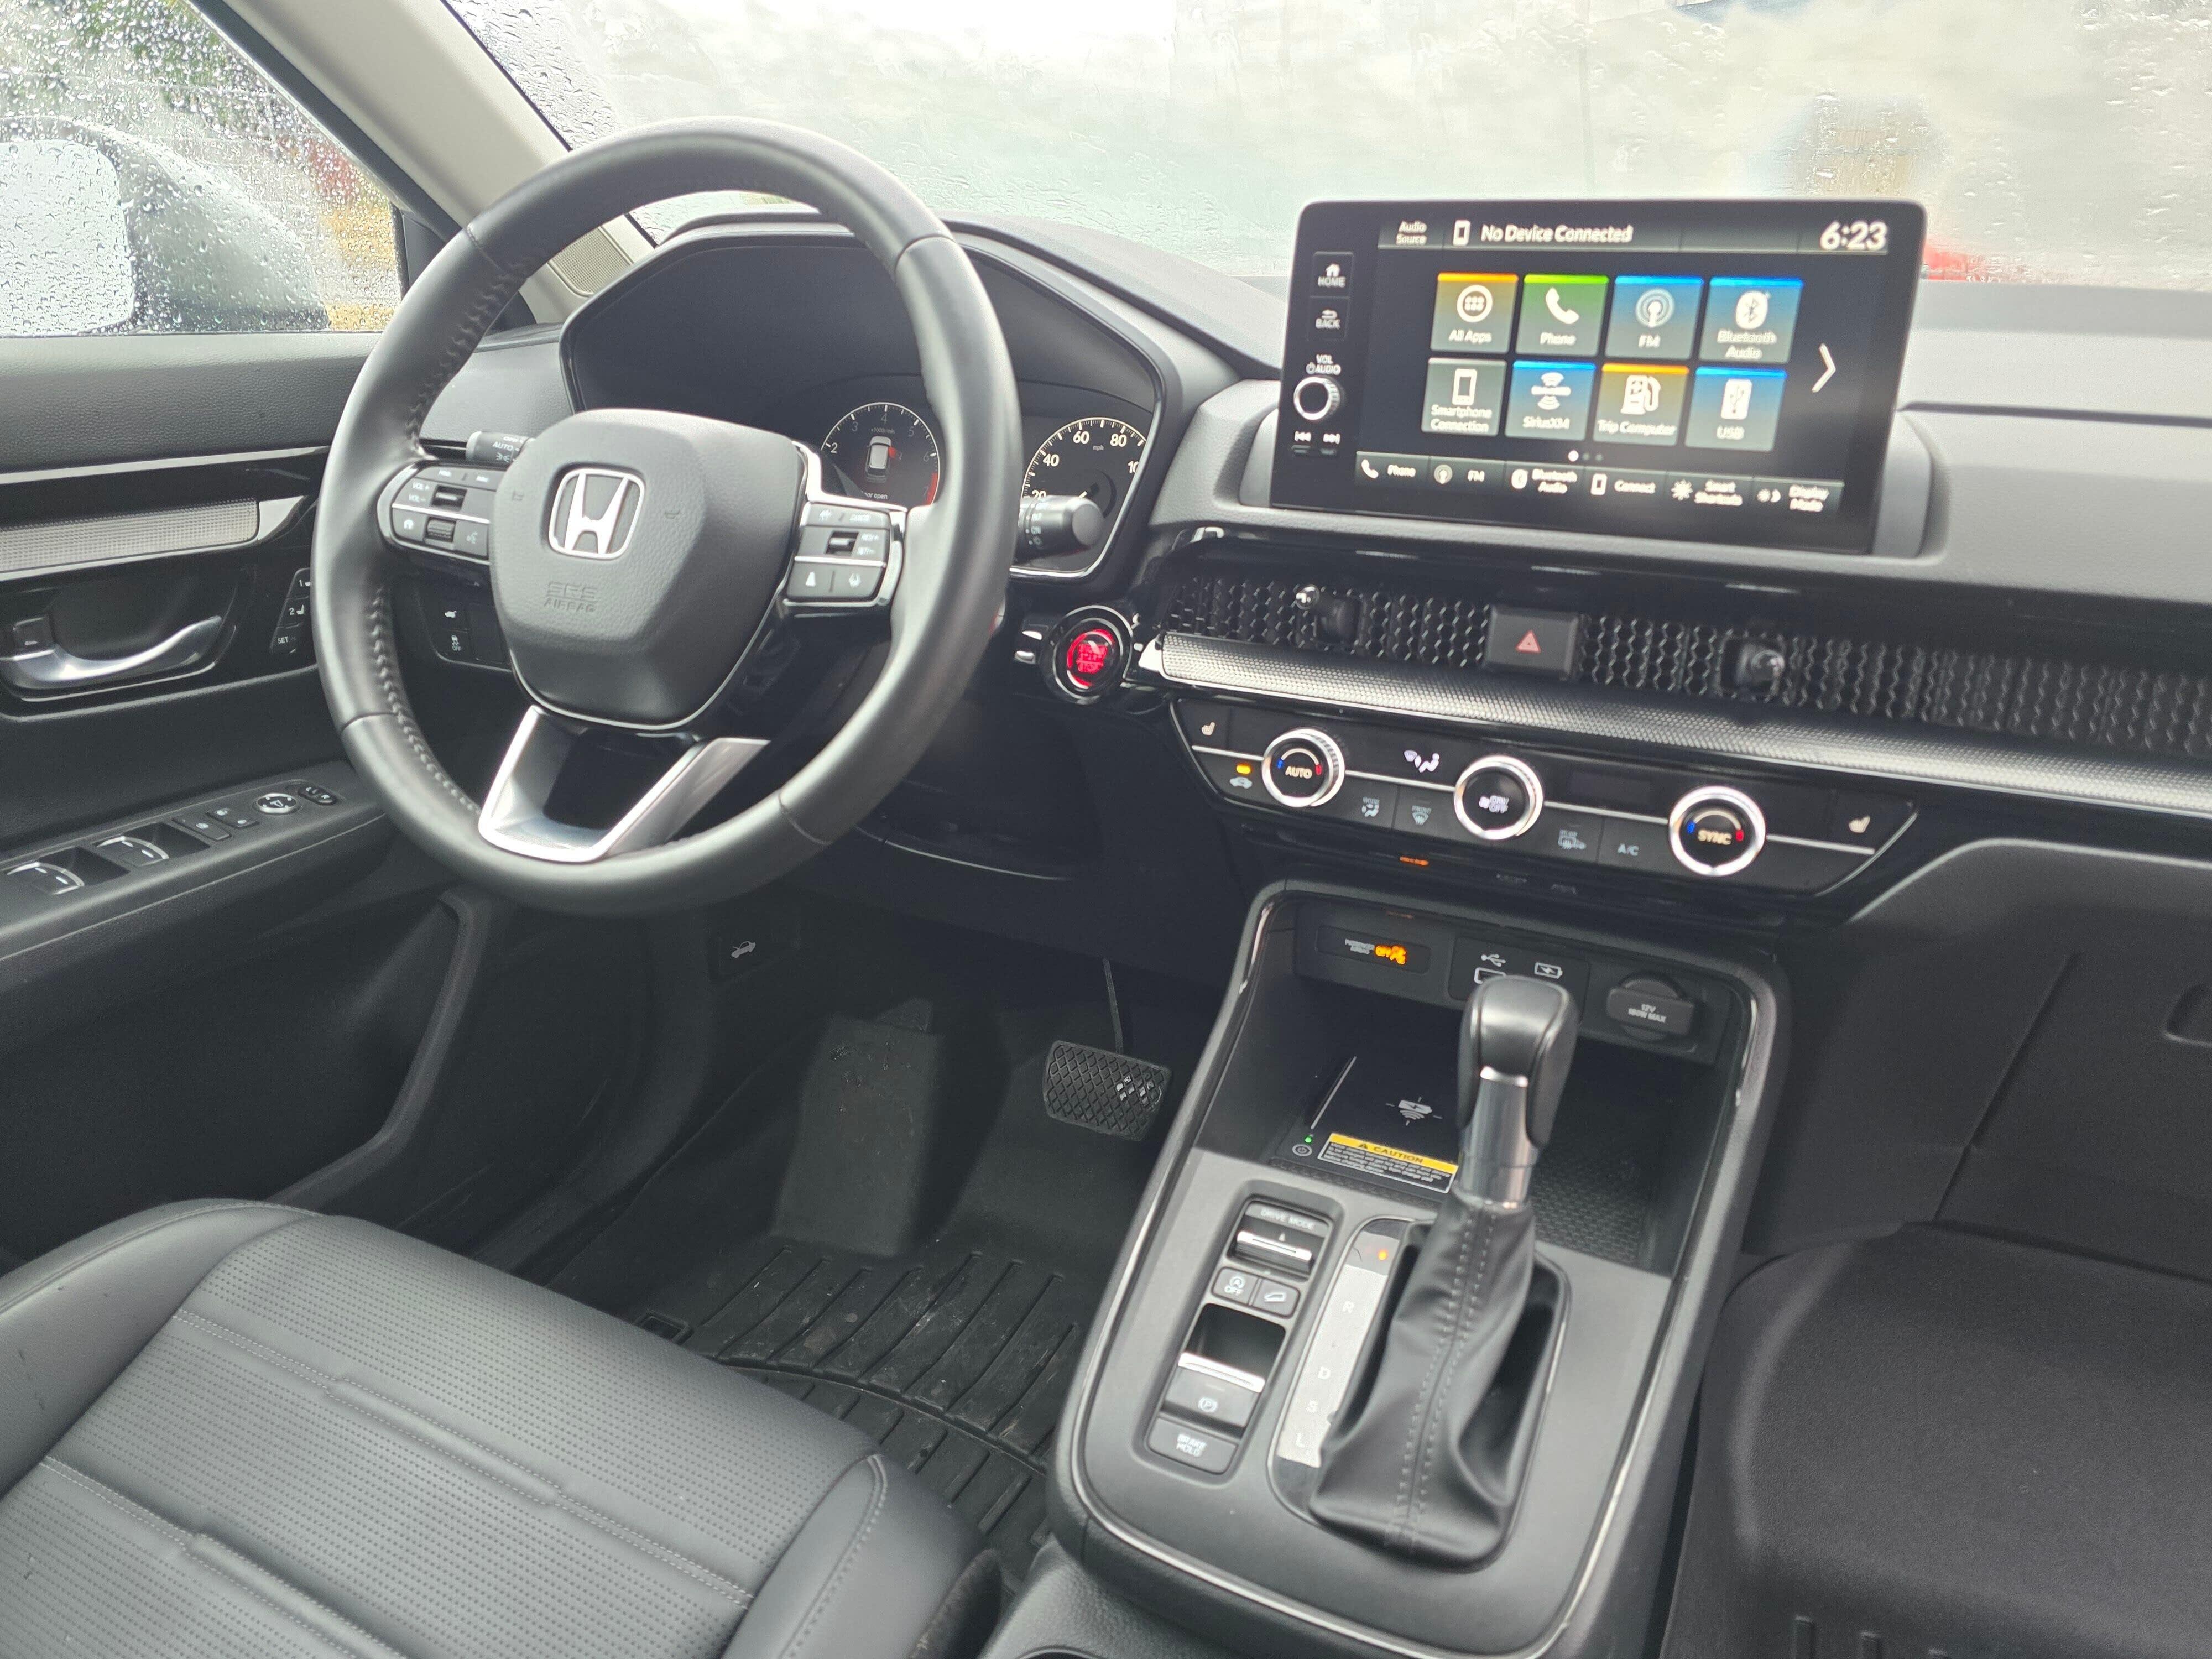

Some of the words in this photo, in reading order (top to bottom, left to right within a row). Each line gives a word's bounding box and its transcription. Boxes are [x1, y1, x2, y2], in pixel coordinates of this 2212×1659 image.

[1399, 221, 1427, 233] Audio
[1481, 224, 1503, 242] No
[1504, 224, 1553, 242] Device
[1554, 225, 1634, 243] Connected
[1396, 233, 1427, 245] Source
[1820, 220, 1887, 250] 6:23
[1317, 276, 1345, 287] HOME
[1316, 319, 1340, 330] BACK
[1448, 329, 1464, 342] All
[1464, 330, 1492, 343] Apps
[1540, 332, 1577, 346] Phone
[1638, 334, 1661, 348] FM
[1717, 329, 1777, 345] Bluetooth
[1316, 354, 1333, 364] VOL
[1725, 345, 1762, 360] Audio
[1316, 364, 1341, 375] AUDIO
[1431, 404, 1492, 419] Smartphone
[880, 414, 888, 424] 4
[1431, 419, 1489, 433] Connection
[1522, 416, 1570, 430] SiriusXM
[852, 421, 859, 432] 3
[908, 426, 915, 437] 5
[1598, 419, 1619, 434] Trip
[1619, 421, 1677, 436] Computer
[1716, 425, 1744, 440] USB
[1073, 430, 1090, 444] 60
[1110, 434, 1127, 447] 80
[492, 441, 514, 451] AUTO
[831, 442, 838, 453] 2
[1042, 453, 1060, 467] 40
[1387, 465, 1416, 477] Phone
[1467, 469, 1485, 482] FM
[1531, 468, 1578, 483] Bluetooth
[1538, 482, 1568, 494] Audio
[289, 607, 295, 615] 2
[277, 636, 288, 645] SET
[1285, 766, 1312, 779] AUTO
[1698, 829, 1732, 846] SYNC
[1617, 843, 1640, 857] A/C
[1373, 1145, 1423, 1164] CAUTION
[1260, 1207, 1287, 1223] DRIVE
[1287, 1215, 1315, 1230] MODE
[1342, 1300, 1355, 1314] R
[1318, 1366, 1331, 1380] D
[1306, 1400, 1319, 1413] S
[1177, 1433, 1207, 1449] BRAKE
[1176, 1442, 1202, 1457] HOLD
